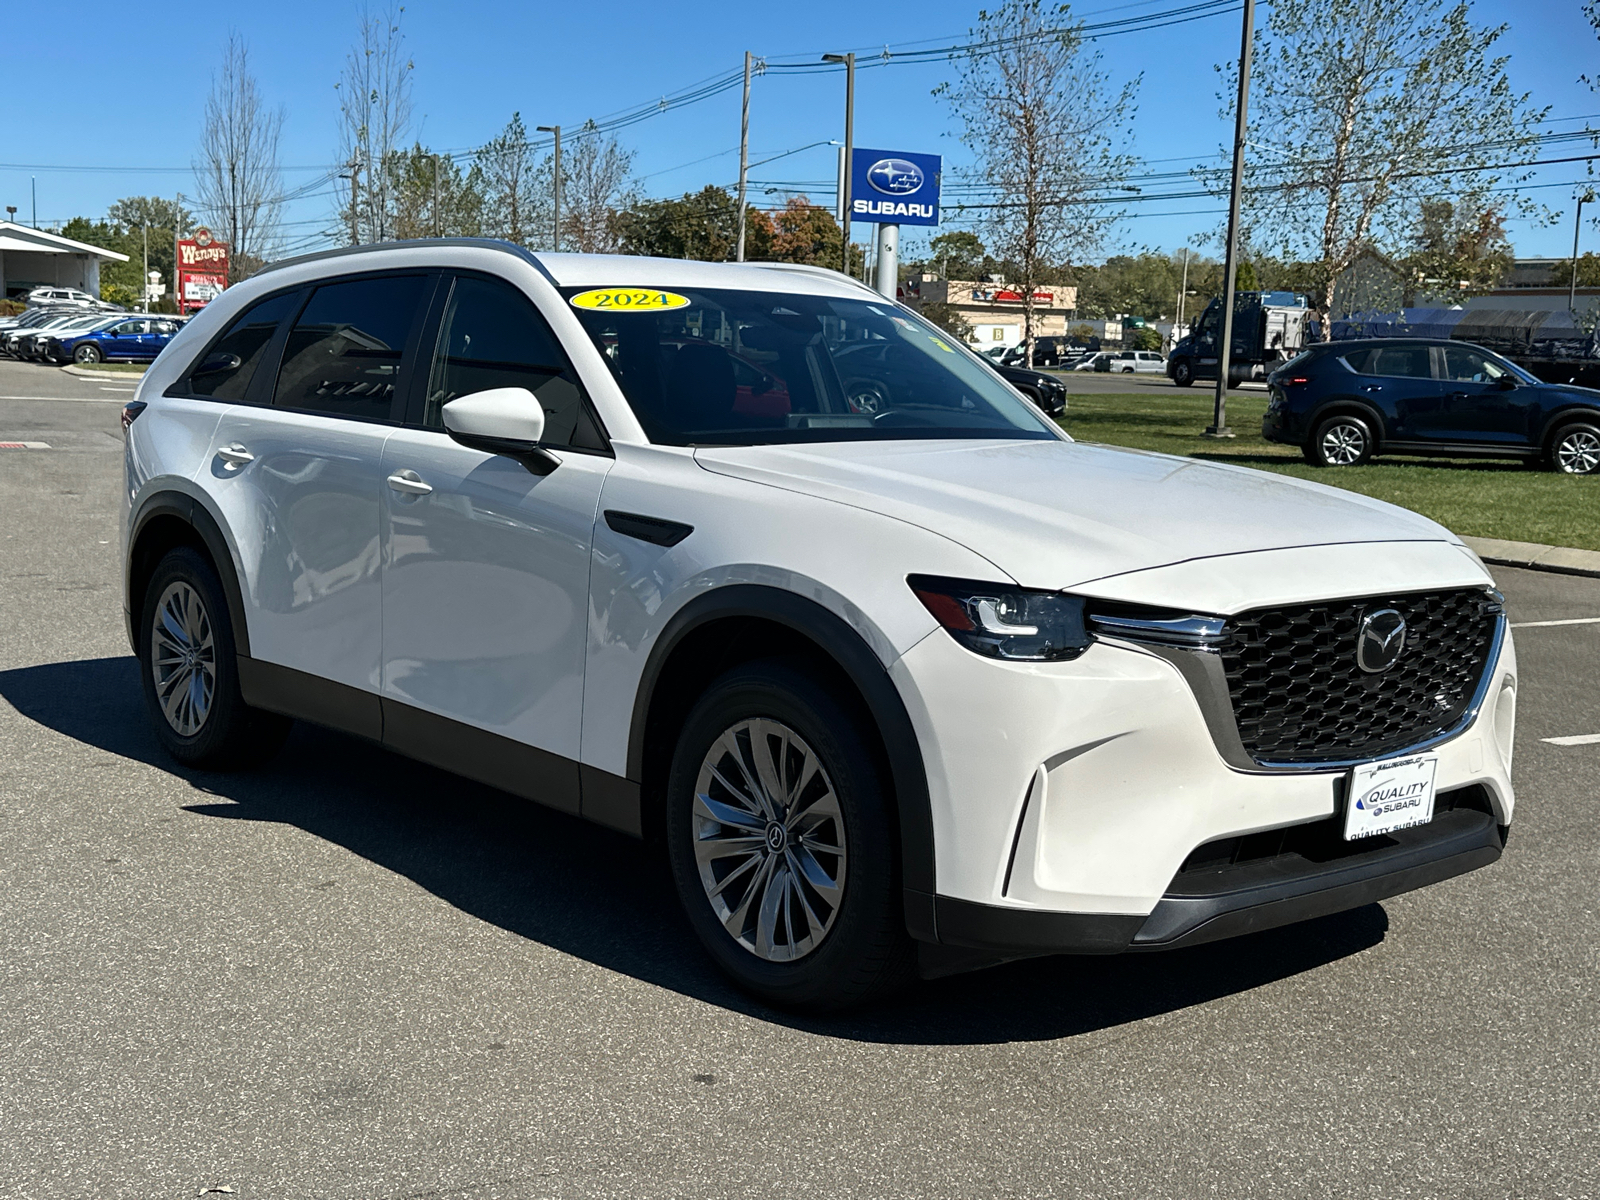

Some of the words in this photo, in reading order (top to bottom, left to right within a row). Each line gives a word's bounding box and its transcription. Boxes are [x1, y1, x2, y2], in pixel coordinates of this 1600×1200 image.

[853, 199, 933, 218] SUBARU
[594, 292, 671, 307] 2024
[1369, 781, 1429, 803] QUALITY
[1383, 798, 1421, 813] SUBARU
[1393, 817, 1430, 832] SUBARU
[1350, 826, 1391, 840] QUALITY
